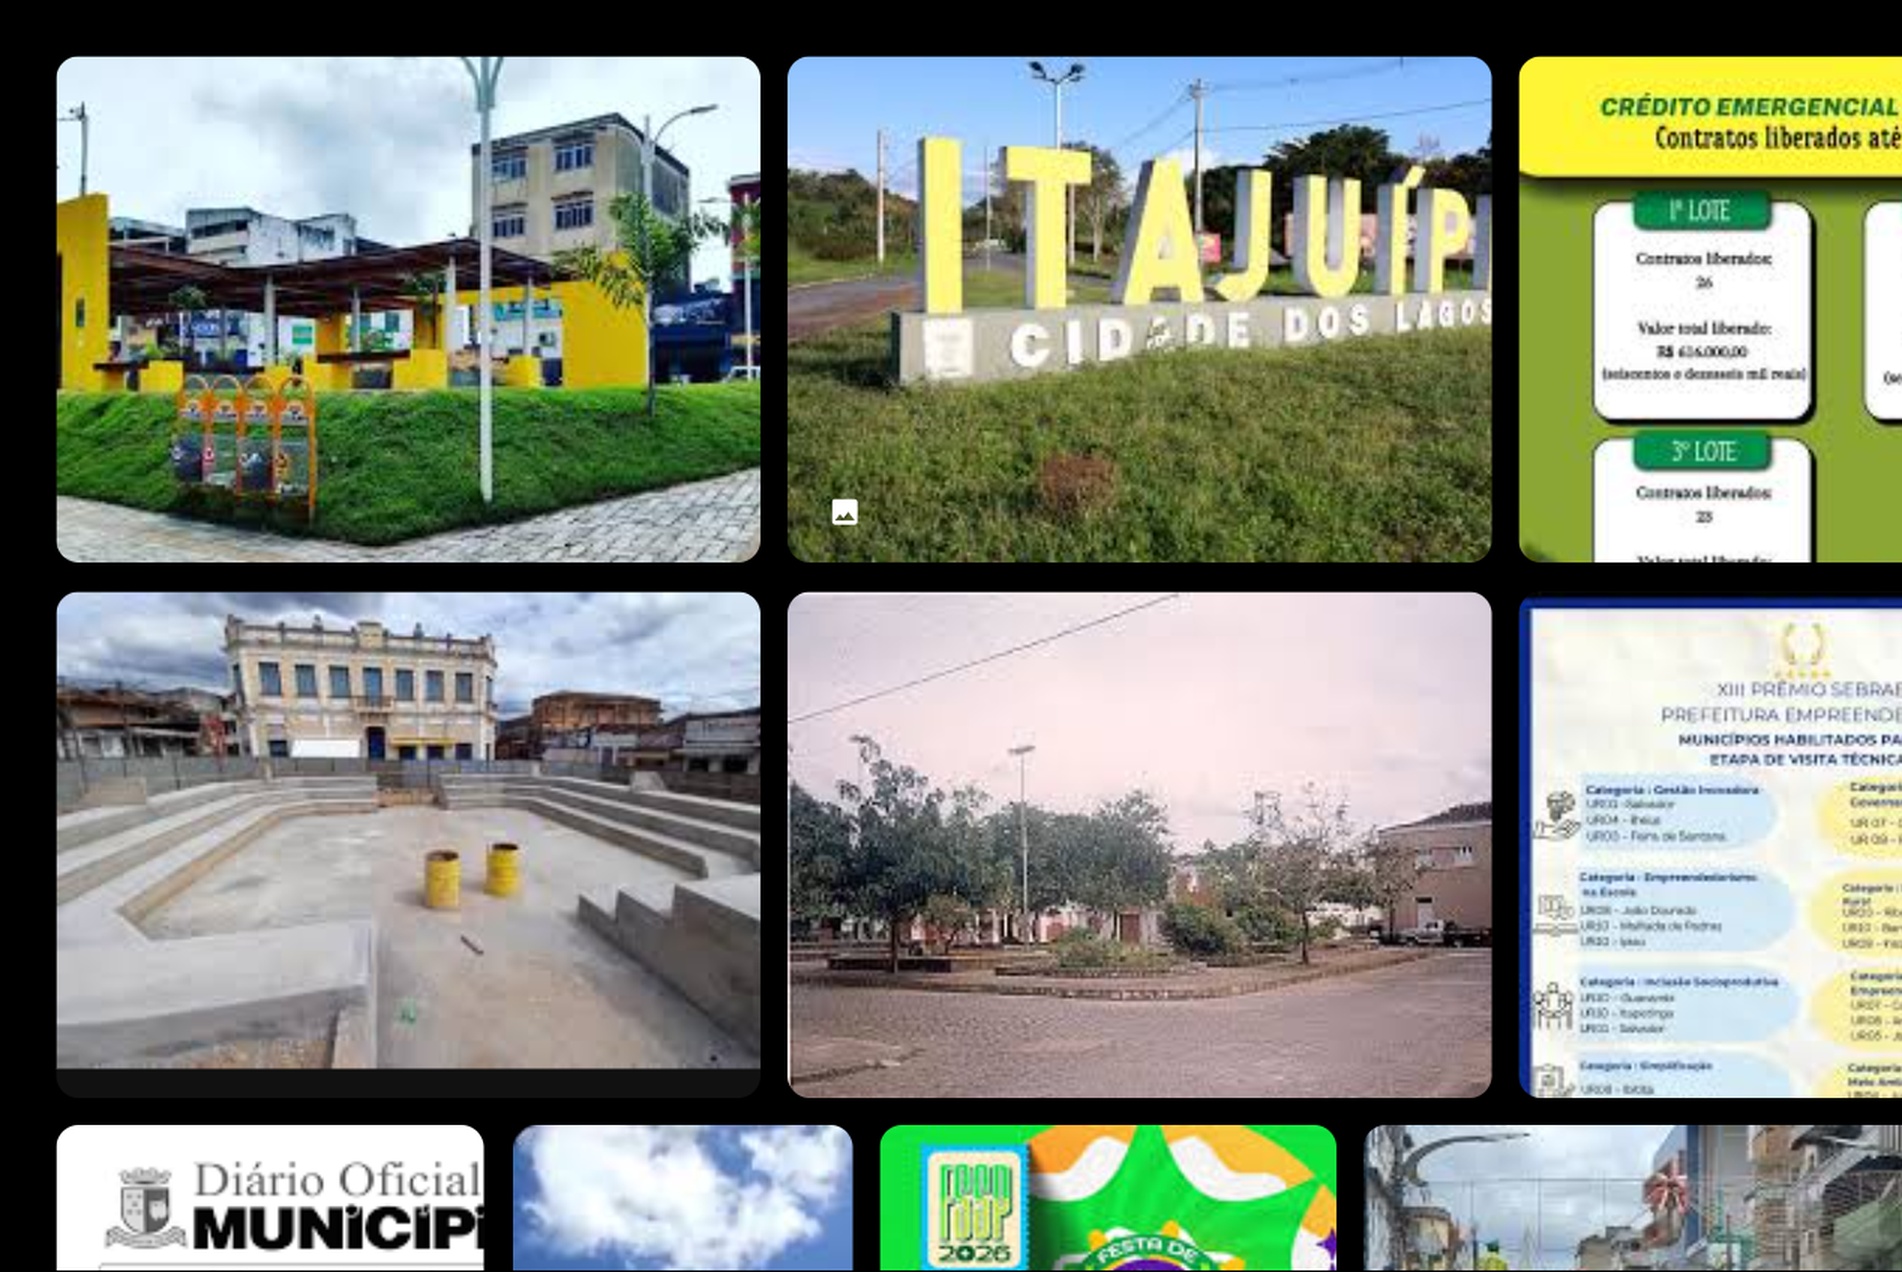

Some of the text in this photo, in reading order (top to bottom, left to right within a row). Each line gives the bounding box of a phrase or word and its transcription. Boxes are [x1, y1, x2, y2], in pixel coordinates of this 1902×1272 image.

[1600, 92, 1900, 117] CRÉDITO EMERGENCIAL
[1655, 124, 1902, 150] Contratos liberados até
[1688, 198, 1732, 222] LOTE
[917, 136, 1491, 315] ITAJUÍP
[1636, 251, 1702, 266] Contratos
[1282, 303, 1370, 343] DOS
[1395, 298, 1491, 333] LAGOS
[1637, 320, 1675, 335] Valor
[1678, 321, 1708, 335] total
[1694, 440, 1739, 462] LOTE
[1636, 485, 1702, 500] Contratos
[1717, 678, 1902, 698] XIII PRÊMIO SEBRAE
[1661, 706, 1902, 723] PREFEITURA EMPREENDE
[1678, 731, 1770, 747] MUNICÍPIOS
[1774, 733, 1878, 747] HABILITADOS
[1709, 753, 1760, 767] ETAPA
[1763, 753, 1785, 767] DE
[1788, 753, 1838, 767] VISITA
[1585, 784, 1645, 797] Categoria
[1579, 872, 1635, 885] Categoria
[1580, 977, 1635, 989] Categoria
[194, 1161, 481, 1197] Diário Oficial
[938, 1245, 1011, 1264] 2026
[1097, 1237, 1198, 1264] FESTA DE
